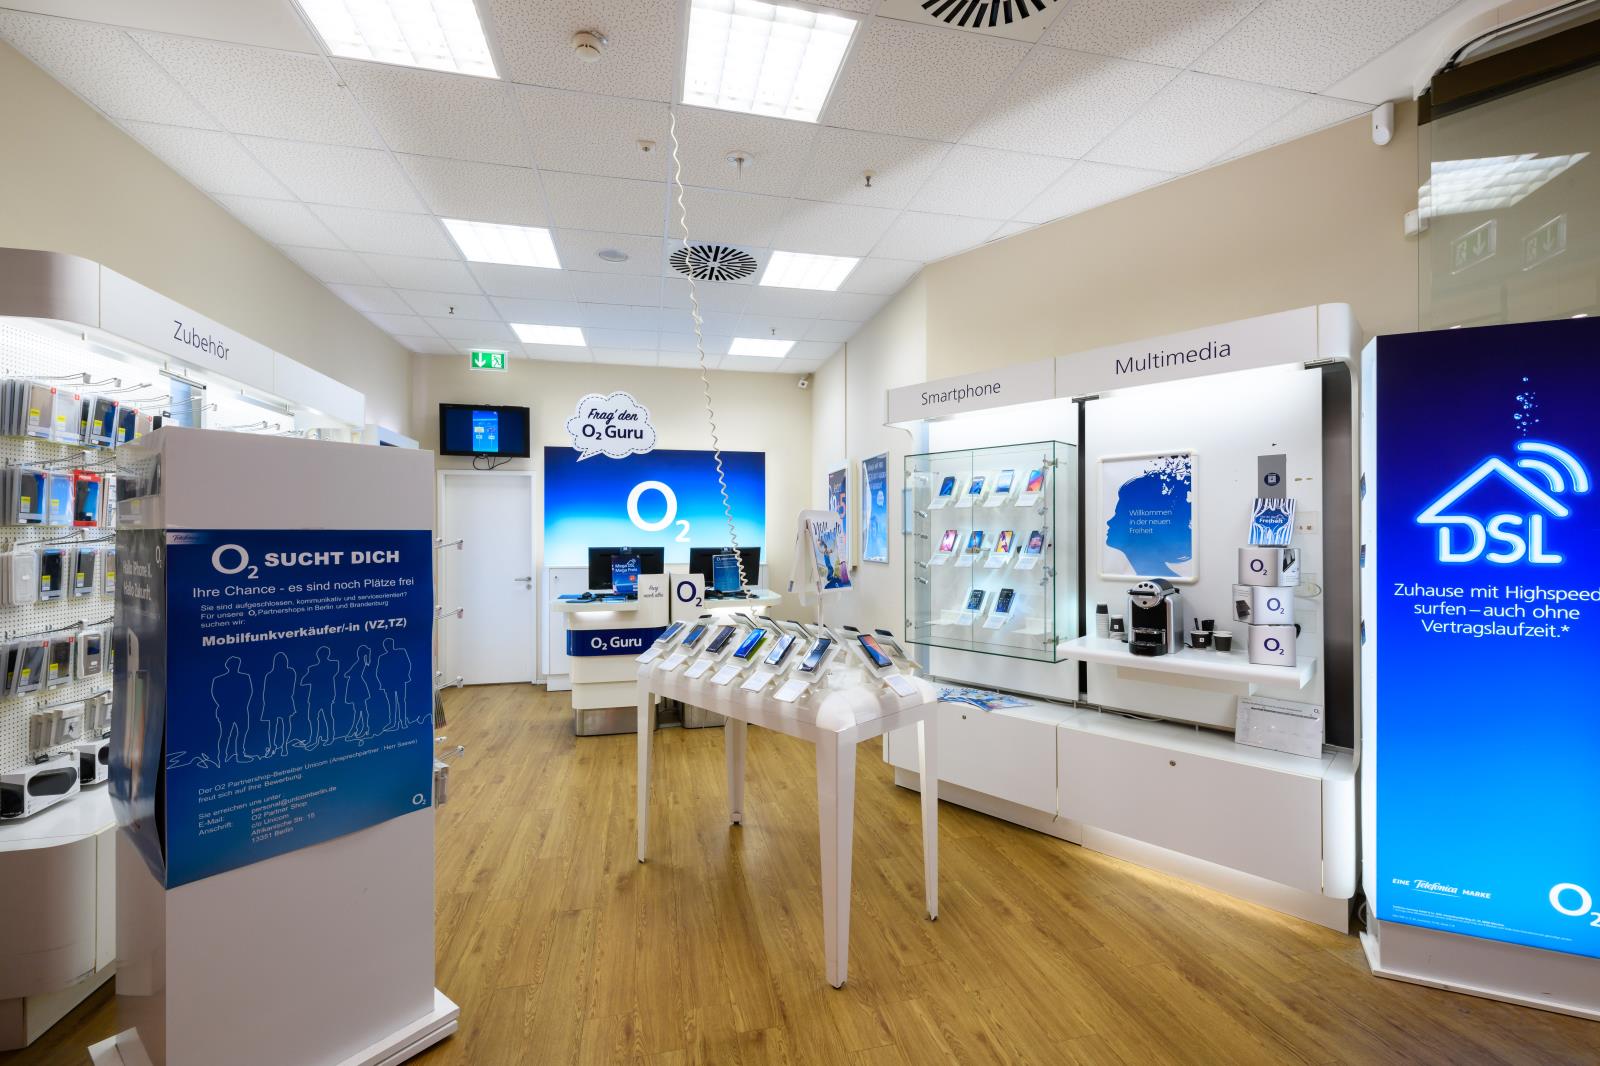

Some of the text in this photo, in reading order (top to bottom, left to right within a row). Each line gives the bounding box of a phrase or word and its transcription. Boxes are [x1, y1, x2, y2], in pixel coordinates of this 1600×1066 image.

[174, 320, 230, 360] Zubehör
[1115, 340, 1232, 376] Multimedia
[921, 380, 1001, 406] Smartphone
[618, 409, 639, 421] den
[582, 424, 644, 440] O2 Guru
[626, 480, 691, 543] O2
[1438, 514, 1563, 564] DSL
[211, 543, 400, 579] O2 SUCHT DICH
[1250, 558, 1267, 576] O2
[193, 587, 220, 598] Ihre
[224, 585, 276, 596] Chance
[288, 584, 303, 593] es
[306, 581, 330, 592] sind
[334, 580, 361, 590] noch
[364, 578, 396, 588] Plätze
[399, 577, 414, 586] frei
[677, 580, 703, 607] O2
[1393, 583, 1600, 604] Zuhause mit Highspeed
[200, 604, 214, 612] Sie
[216, 603, 233, 611] sind
[344, 594, 356, 602] und
[200, 612, 214, 620] Für
[350, 600, 389, 609] Brandenburg
[1266, 597, 1285, 615] O2
[1414, 601, 1466, 616] surfen
[1483, 604, 1526, 619] auch
[1532, 604, 1580, 620] ohne
[200, 620, 230, 629] suchen
[202, 617, 408, 647] Mobilfunkverkäufer/-in (VZ,TZ)
[590, 636, 642, 651] O2 Guru
[1263, 638, 1285, 655] O2
[198, 787, 213, 796] Der
[198, 794, 216, 804] freut
[218, 790, 233, 799] sich
[234, 786, 246, 795] auf
[412, 793, 427, 805] O2
[198, 812, 212, 820] Sie
[213, 803, 248, 817] erreichen
[249, 799, 262, 807] uns
[1392, 878, 1411, 886] EINE
[1462, 889, 1492, 899] MARKE
[1548, 882, 1600, 928] O2
